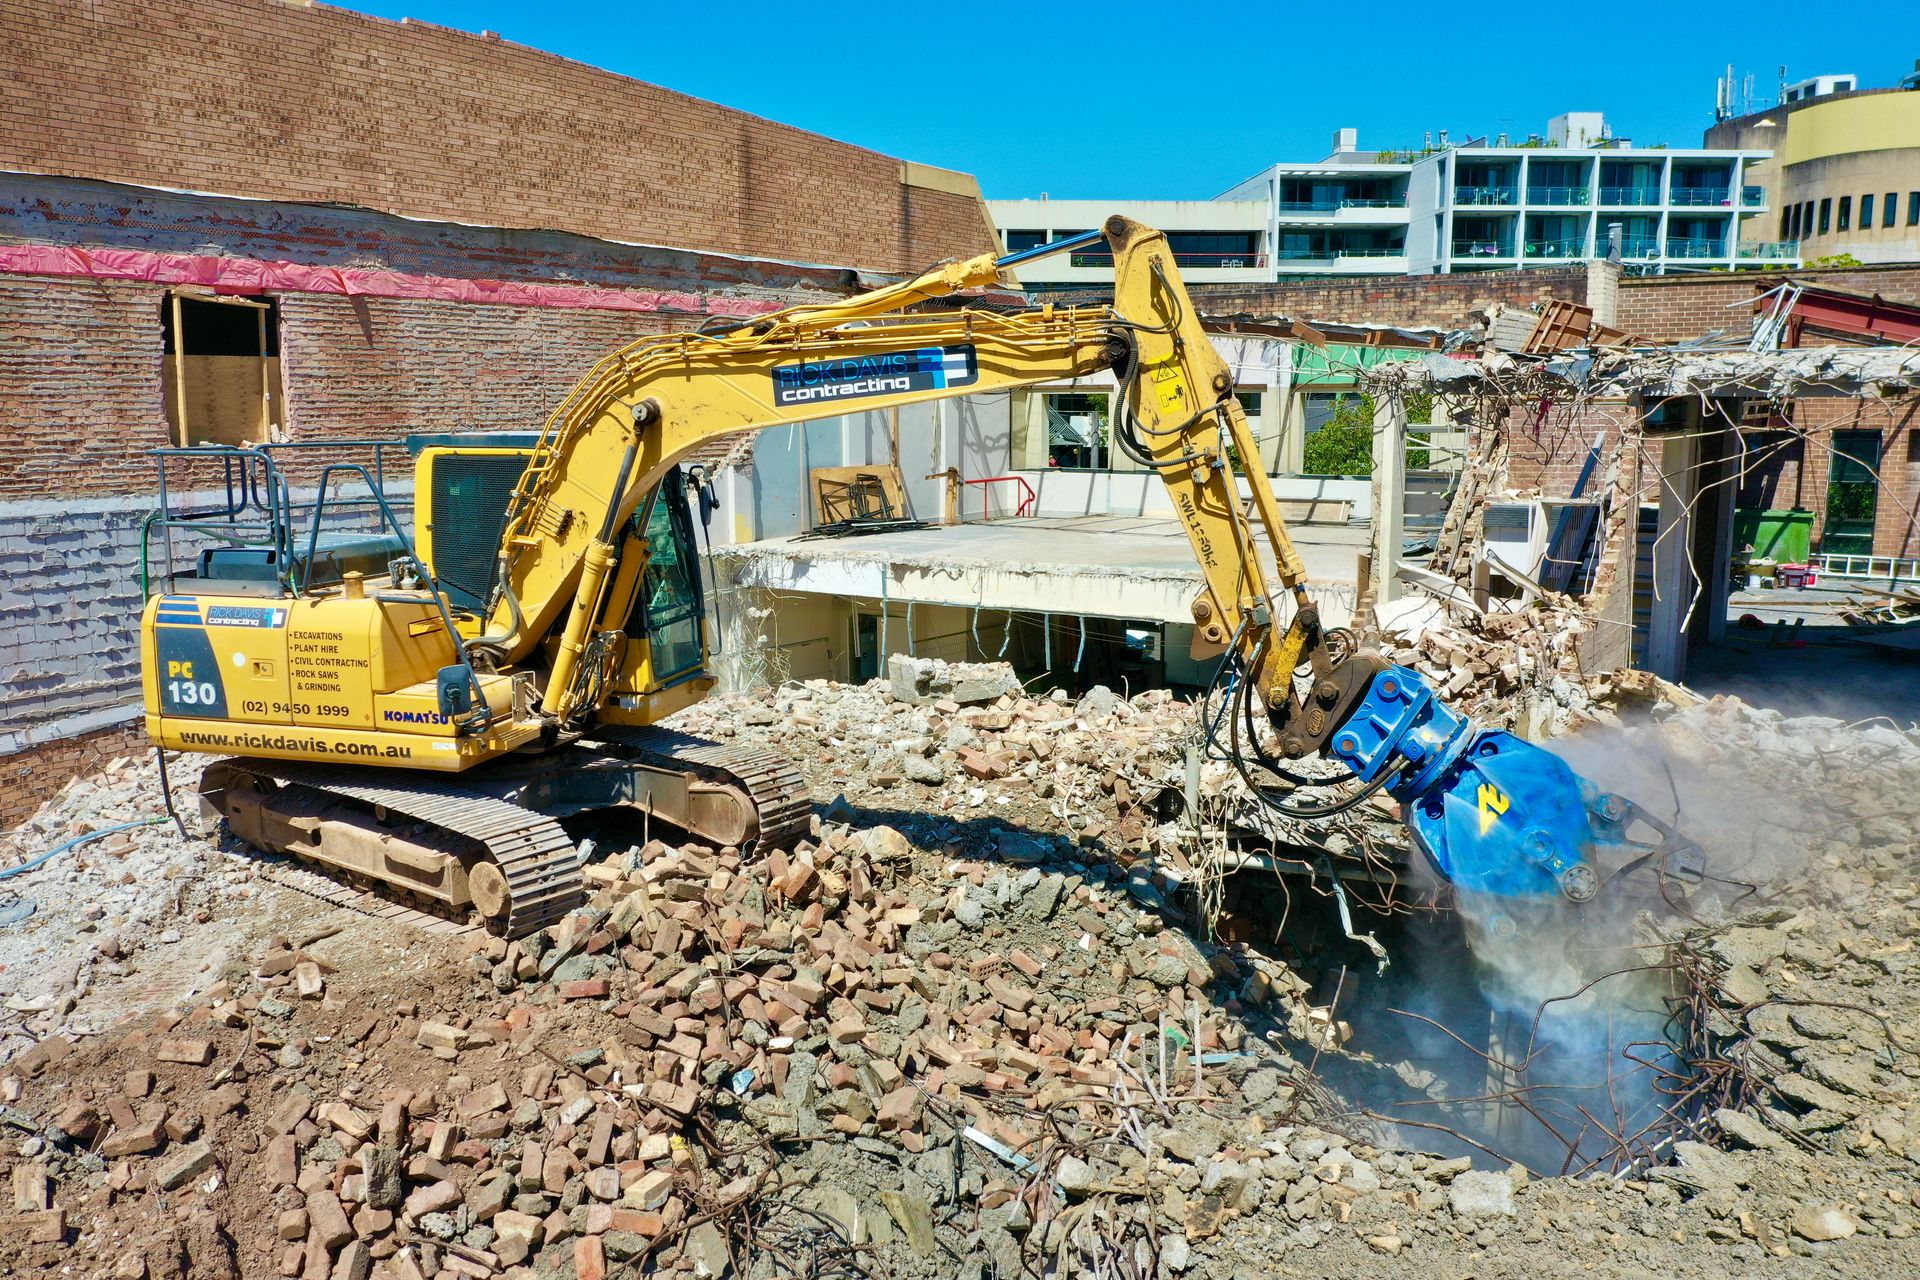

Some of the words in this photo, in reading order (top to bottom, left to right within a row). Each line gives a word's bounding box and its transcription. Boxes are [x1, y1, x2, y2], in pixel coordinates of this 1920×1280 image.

[780, 363, 836, 388] RICK
[842, 354, 908, 381] DAVIS
[782, 376, 911, 402] contracting
[1180, 493, 1196, 522] SWL
[209, 607, 234, 617] RICK
[234, 608, 261, 619] DAVIS
[207, 617, 260, 626] contracting
[293, 631, 343, 641] EXCAVATIONS
[294, 644, 318, 653] PLANT
[320, 645, 338, 653] HIRE
[168, 661, 193, 679] PC
[294, 657, 313, 666] CIVIL
[315, 657, 369, 668] CONTRACTING
[295, 669, 316, 678] ROCK
[317, 670, 339, 680] SAWS
[168, 680, 216, 705] 130
[297, 682, 304, 691] &
[304, 682, 341, 692] GRINDING
[242, 700, 268, 715] (02)
[272, 702, 311, 715] 9450
[316, 704, 350, 717] 1999
[383, 710, 449, 725] KOMATSU
[179, 731, 412, 759] www.rickdavis.com.au
